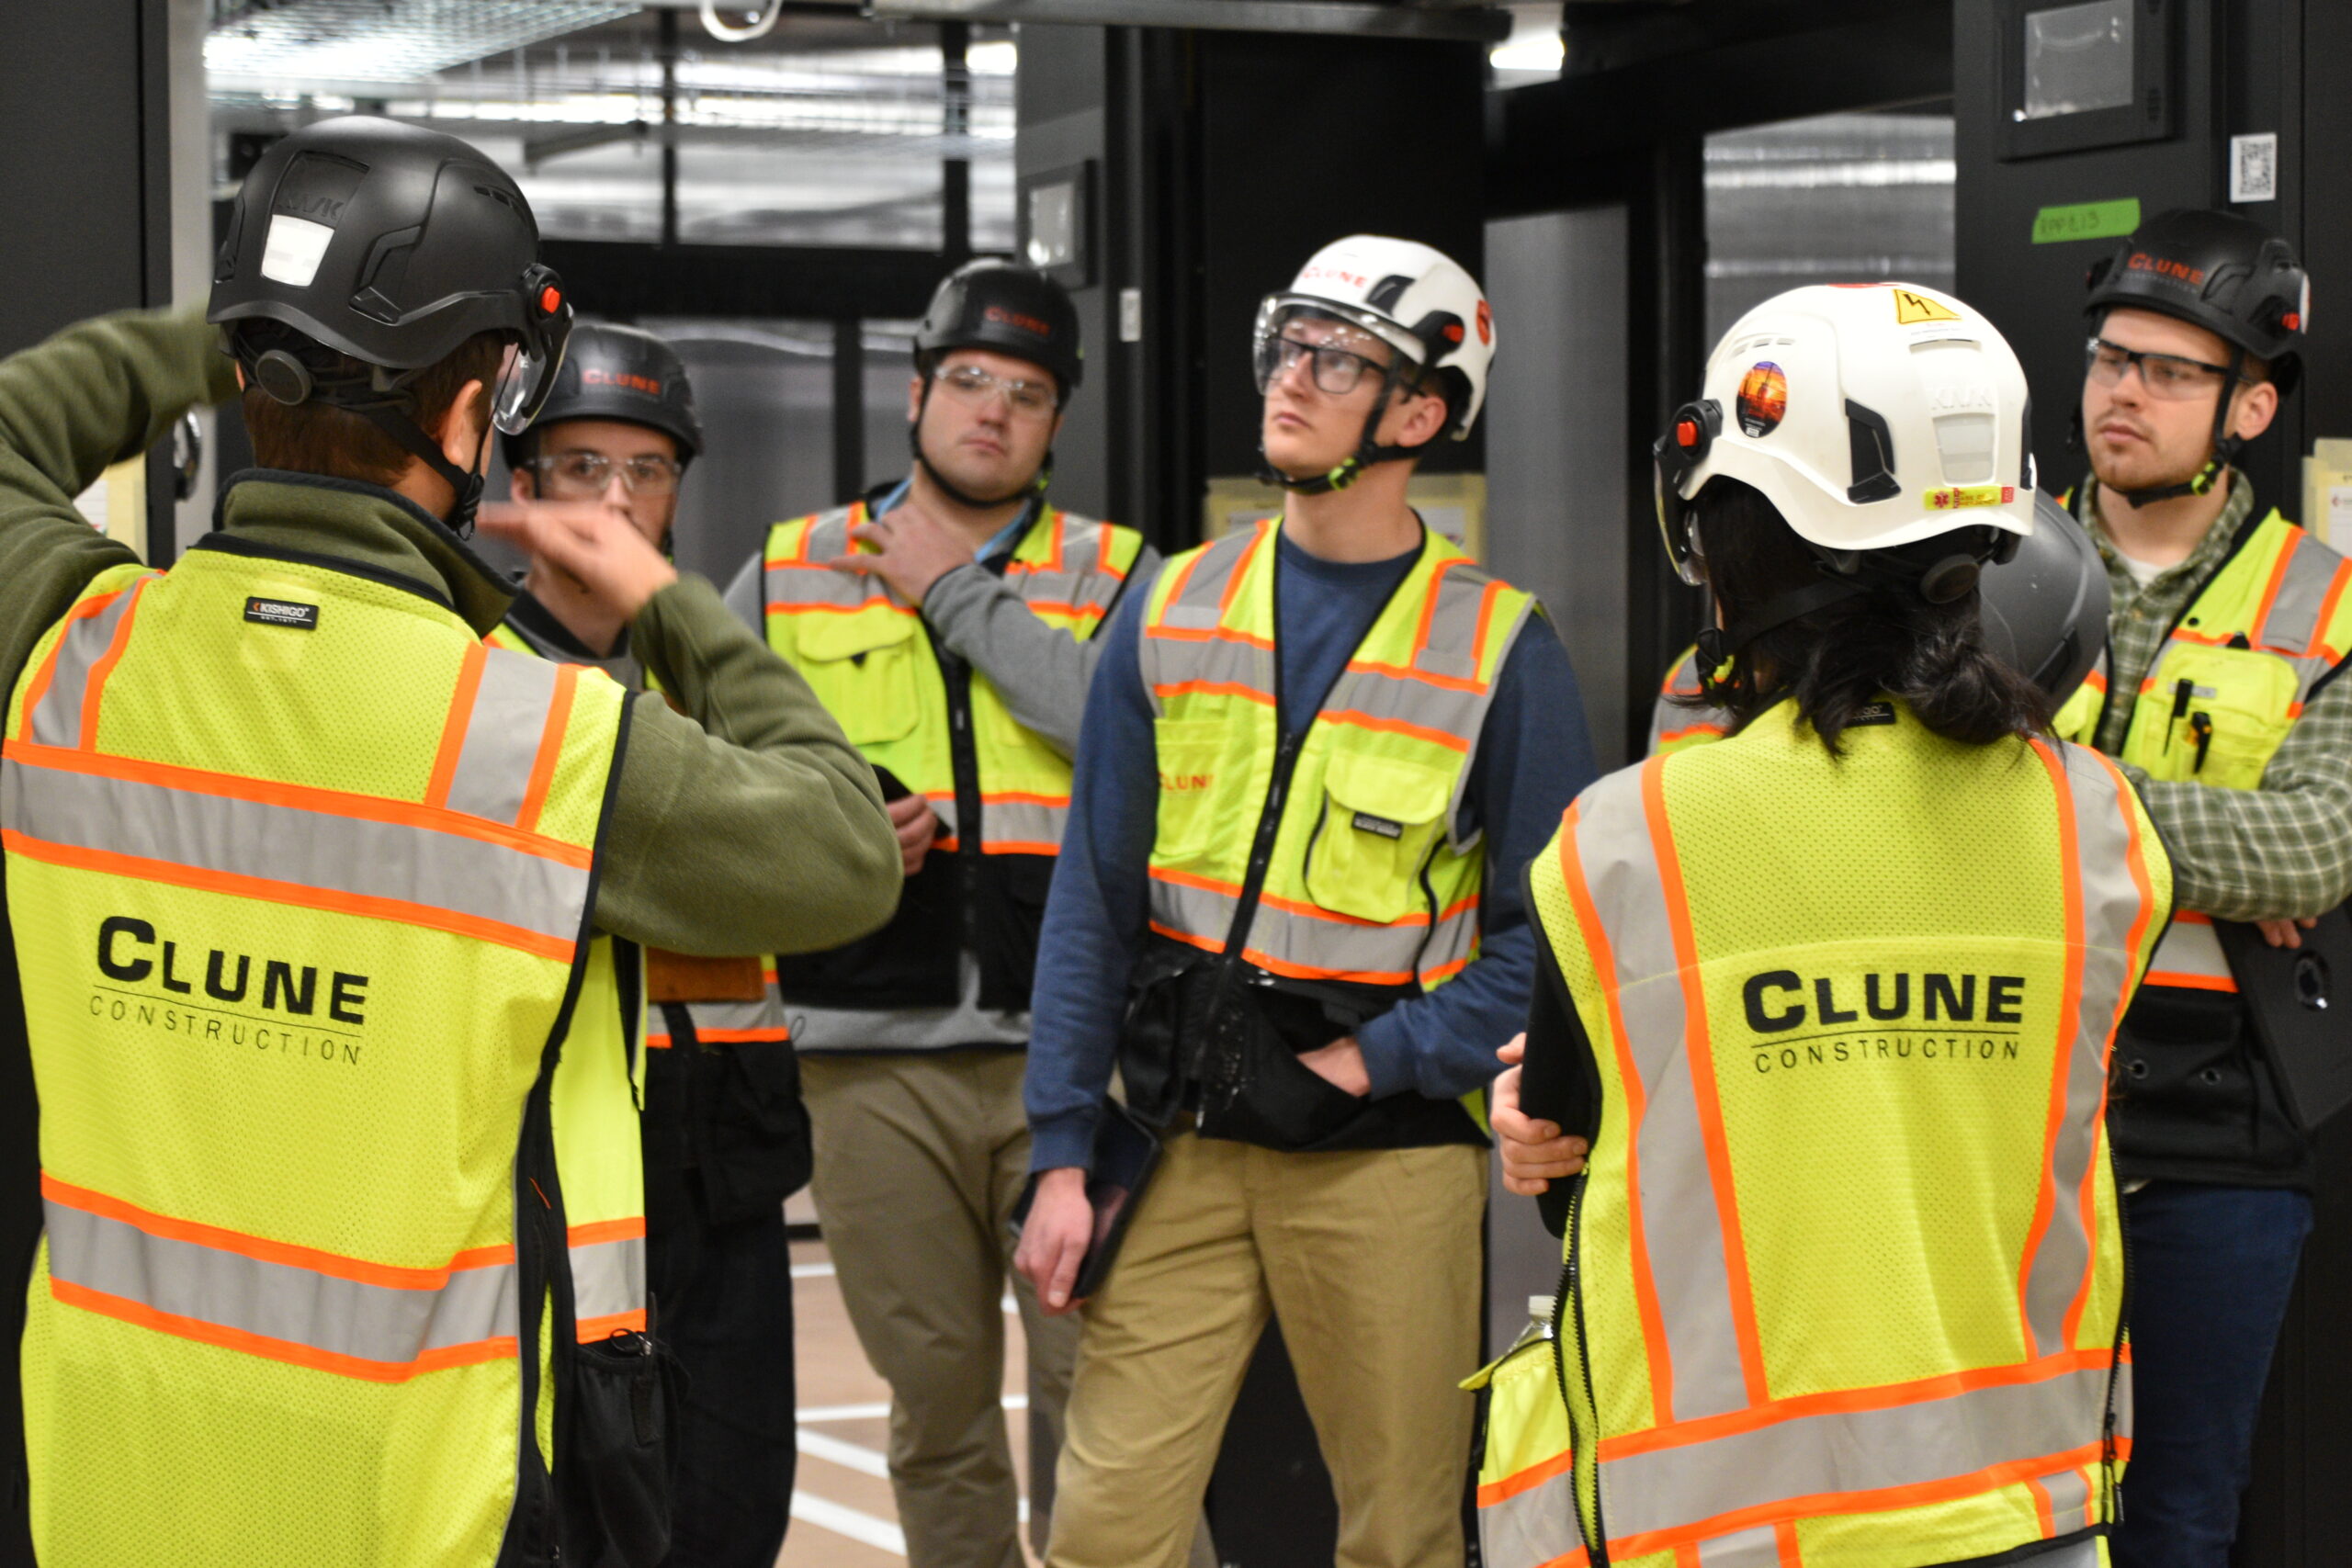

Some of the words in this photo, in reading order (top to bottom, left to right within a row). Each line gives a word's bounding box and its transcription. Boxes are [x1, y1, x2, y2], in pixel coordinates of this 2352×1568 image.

[2128, 253, 2204, 285] CLUNE
[582, 367, 661, 395] CLUNE
[260, 603, 306, 618] KISHIGO
[97, 916, 368, 1025] CLUNE
[1742, 969, 2025, 1034] CLUNE
[90, 996, 361, 1066] CONSTRUCTION
[1755, 1038, 2019, 1073] CONSTRUCTION
